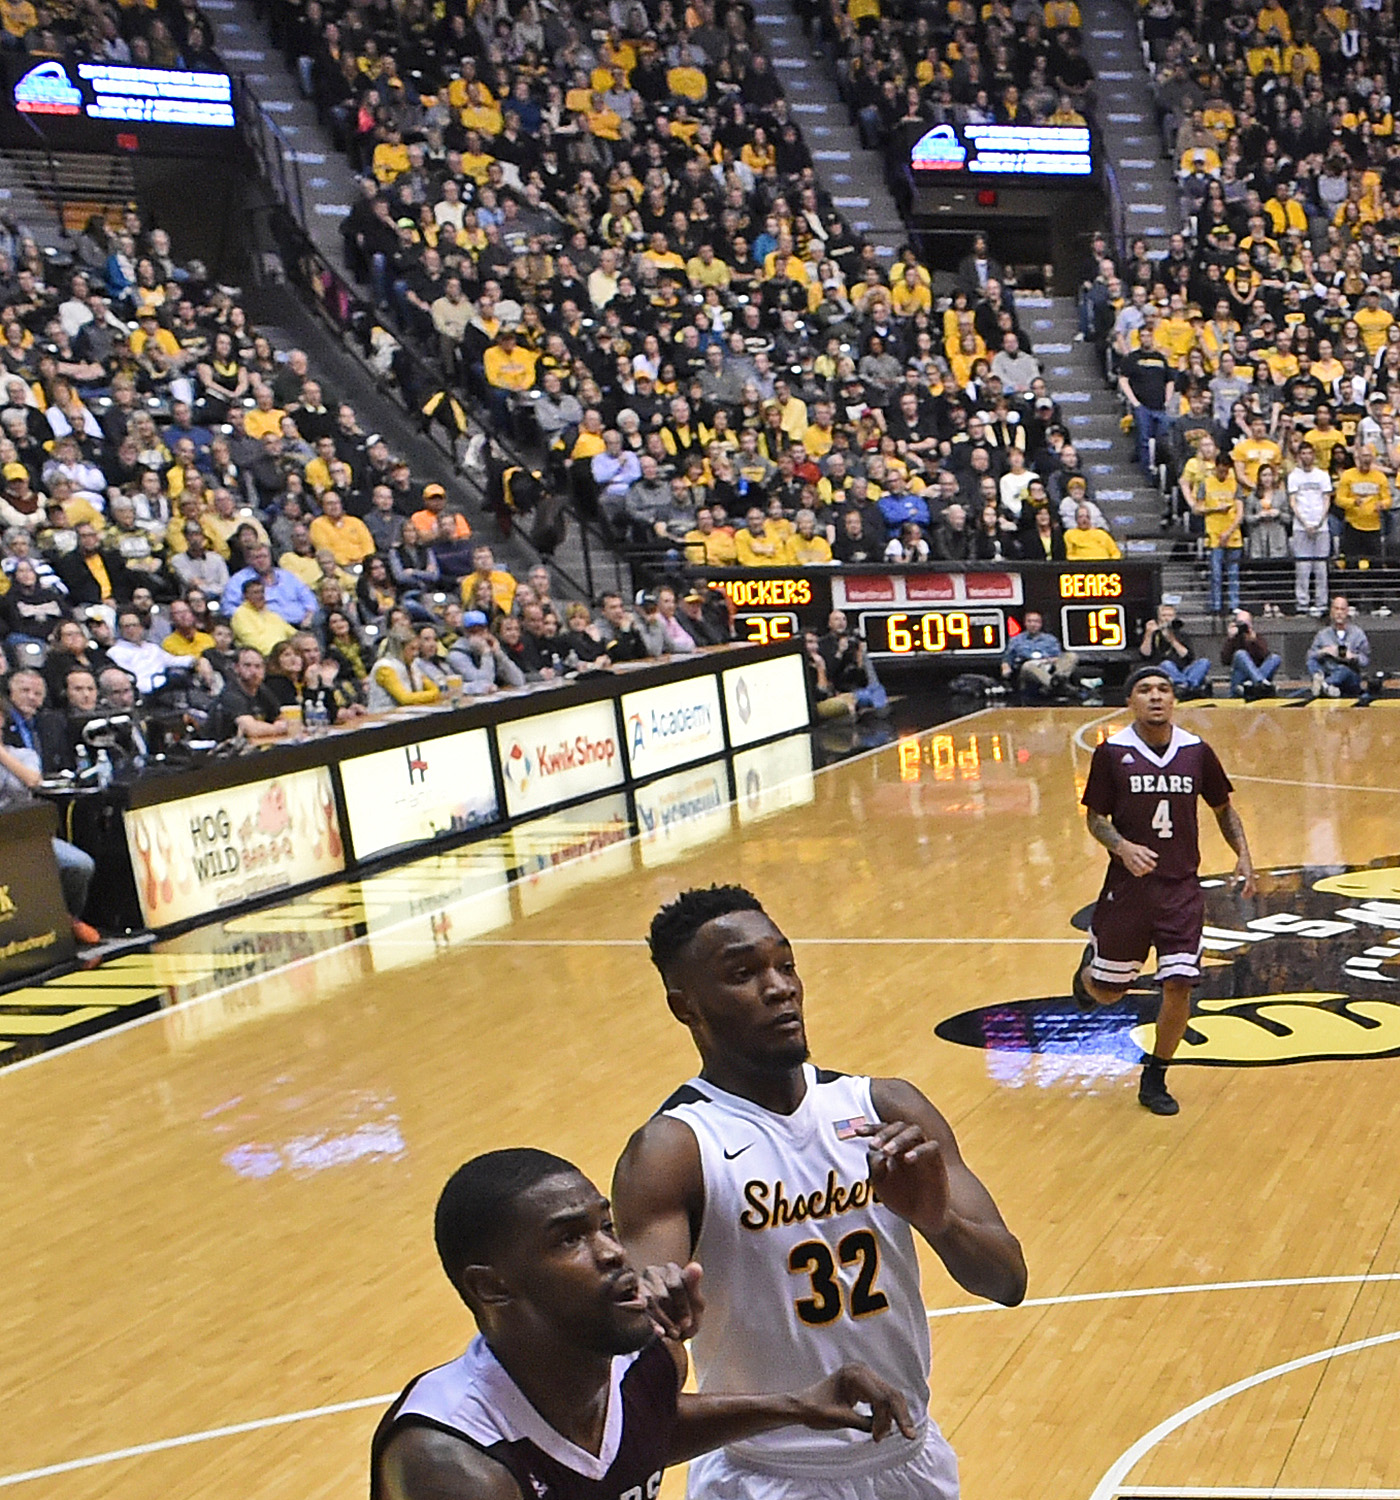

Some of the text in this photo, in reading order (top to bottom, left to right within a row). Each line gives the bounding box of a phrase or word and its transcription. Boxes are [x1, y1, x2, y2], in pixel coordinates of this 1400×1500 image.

[1060, 573, 1122, 598] BEARS
[886, 612, 972, 653] 6:09
[1088, 608, 1121, 646] 15
[651, 701, 711, 737] Academy
[1129, 774, 1193, 794] BEARS
[189, 808, 231, 847] HOG
[1152, 799, 1173, 838] 4
[191, 846, 240, 882] WILD
[740, 1169, 884, 1232] Shocker
[787, 1228, 890, 1329] 32
